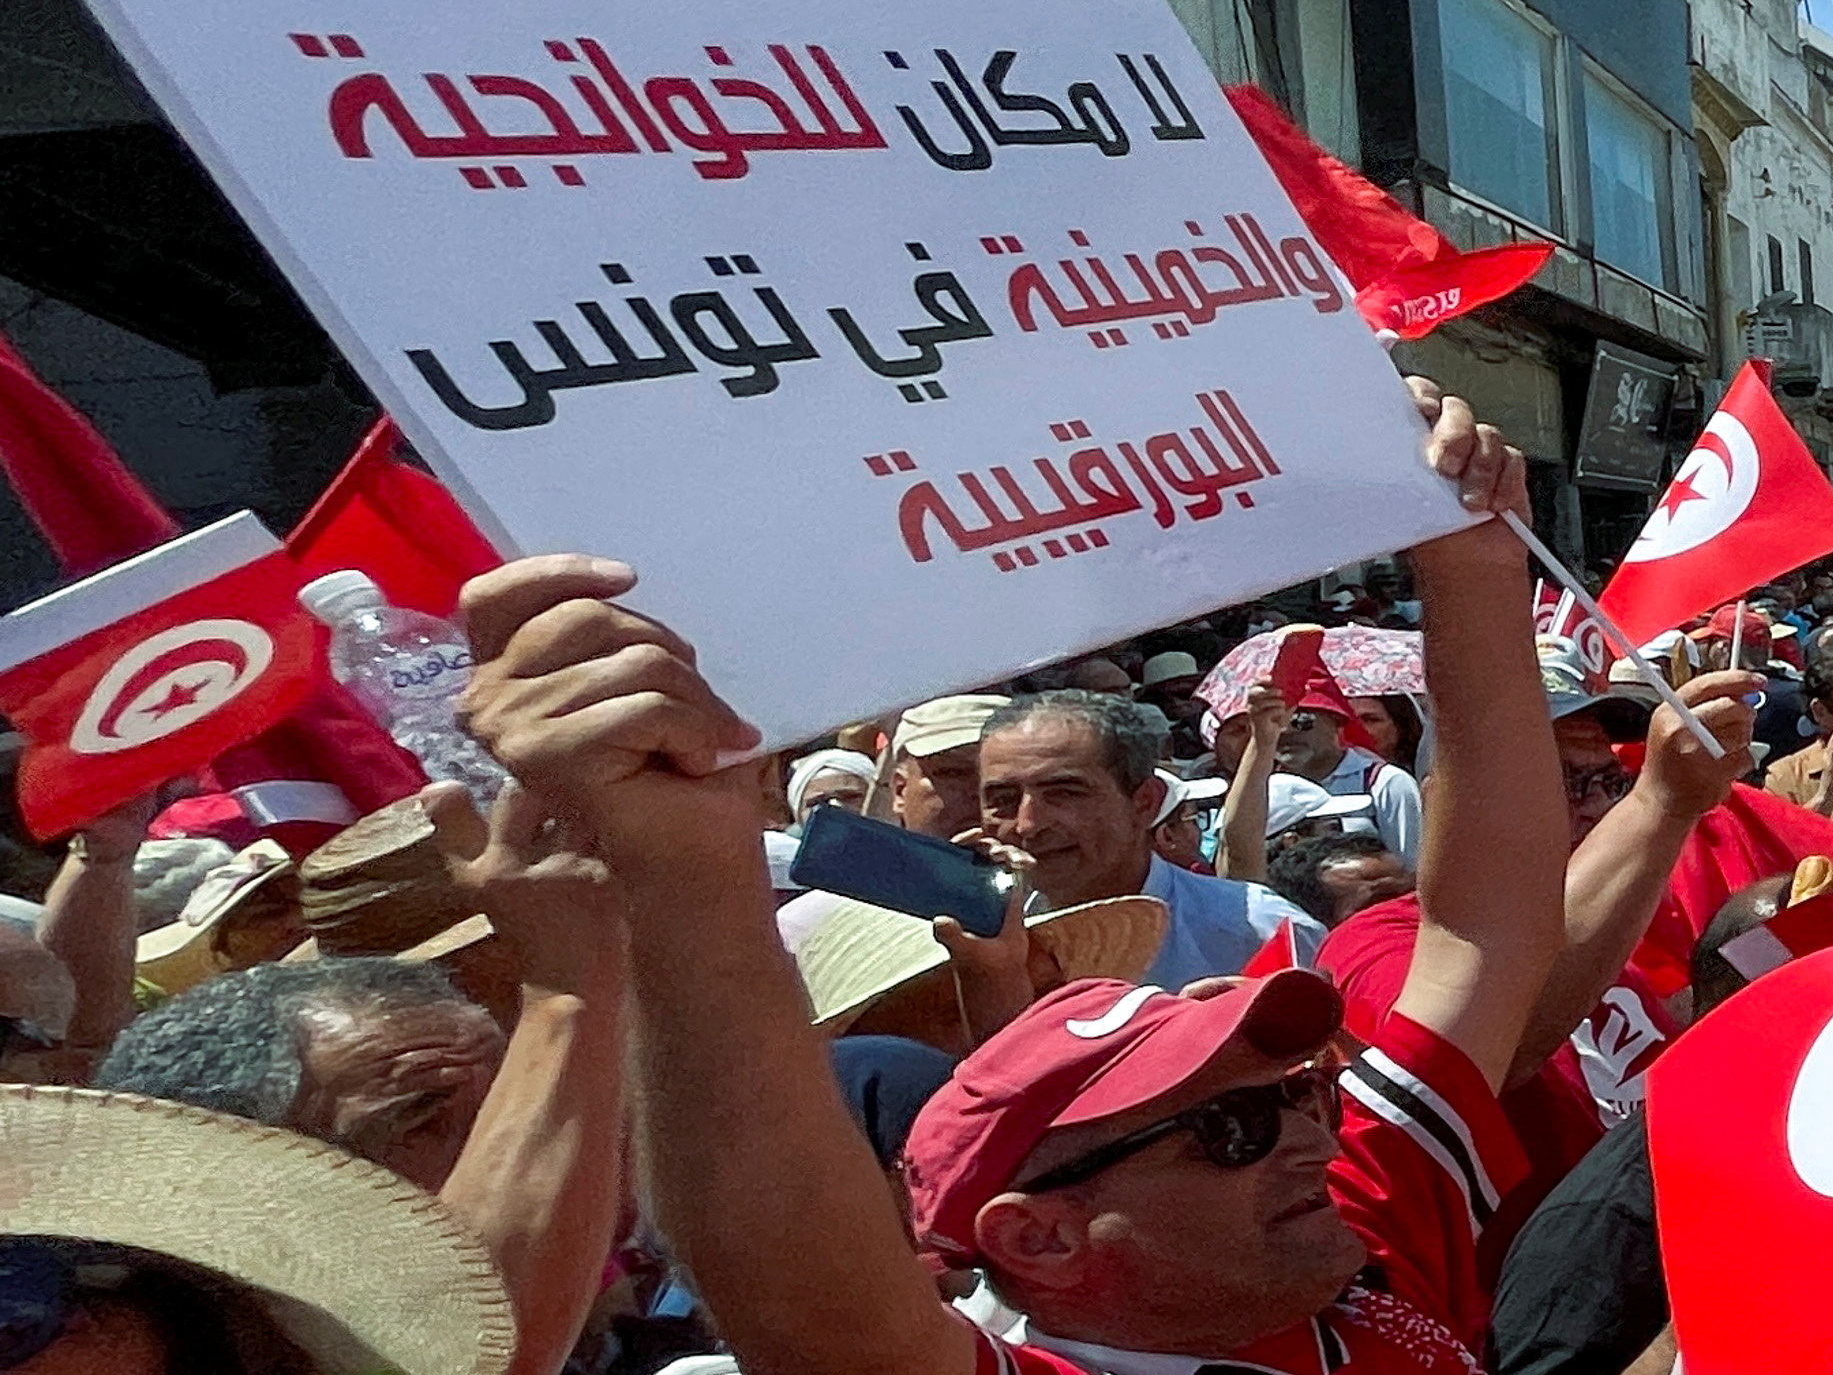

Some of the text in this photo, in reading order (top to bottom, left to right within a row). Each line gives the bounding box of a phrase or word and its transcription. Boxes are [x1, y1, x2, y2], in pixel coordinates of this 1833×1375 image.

[288, 33, 1205, 189] لا مكان للخوانجية
[406, 213, 1343, 431] والخمينية في تونس
[863, 390, 1281, 572] البورقيبية
